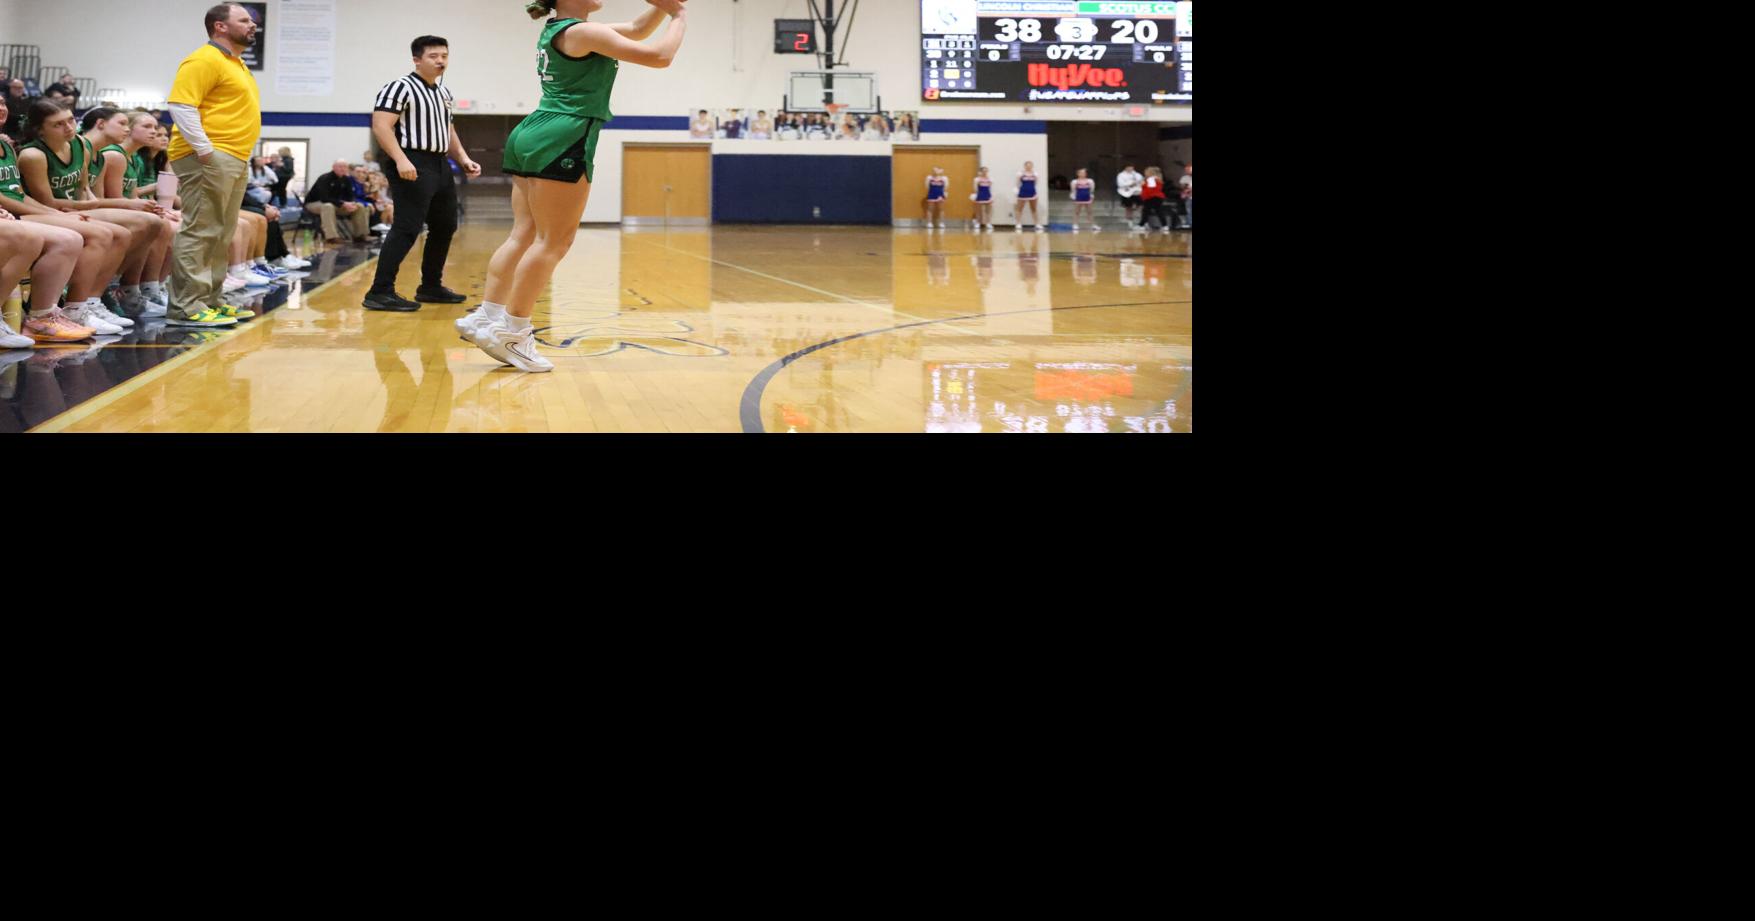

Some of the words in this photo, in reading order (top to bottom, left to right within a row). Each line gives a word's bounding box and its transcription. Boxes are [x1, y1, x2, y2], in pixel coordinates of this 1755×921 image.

[1099, 3, 1152, 13] SCOTUS
[994, 18, 1042, 43] 38
[1072, 26, 1082, 39] 3
[1111, 19, 1159, 44] 20
[794, 33, 809, 51] 2
[988, 50, 1000, 61] 0
[1046, 44, 1107, 60] 07:27
[1153, 52, 1165, 63] 0
[51, 169, 80, 189] SCOT
